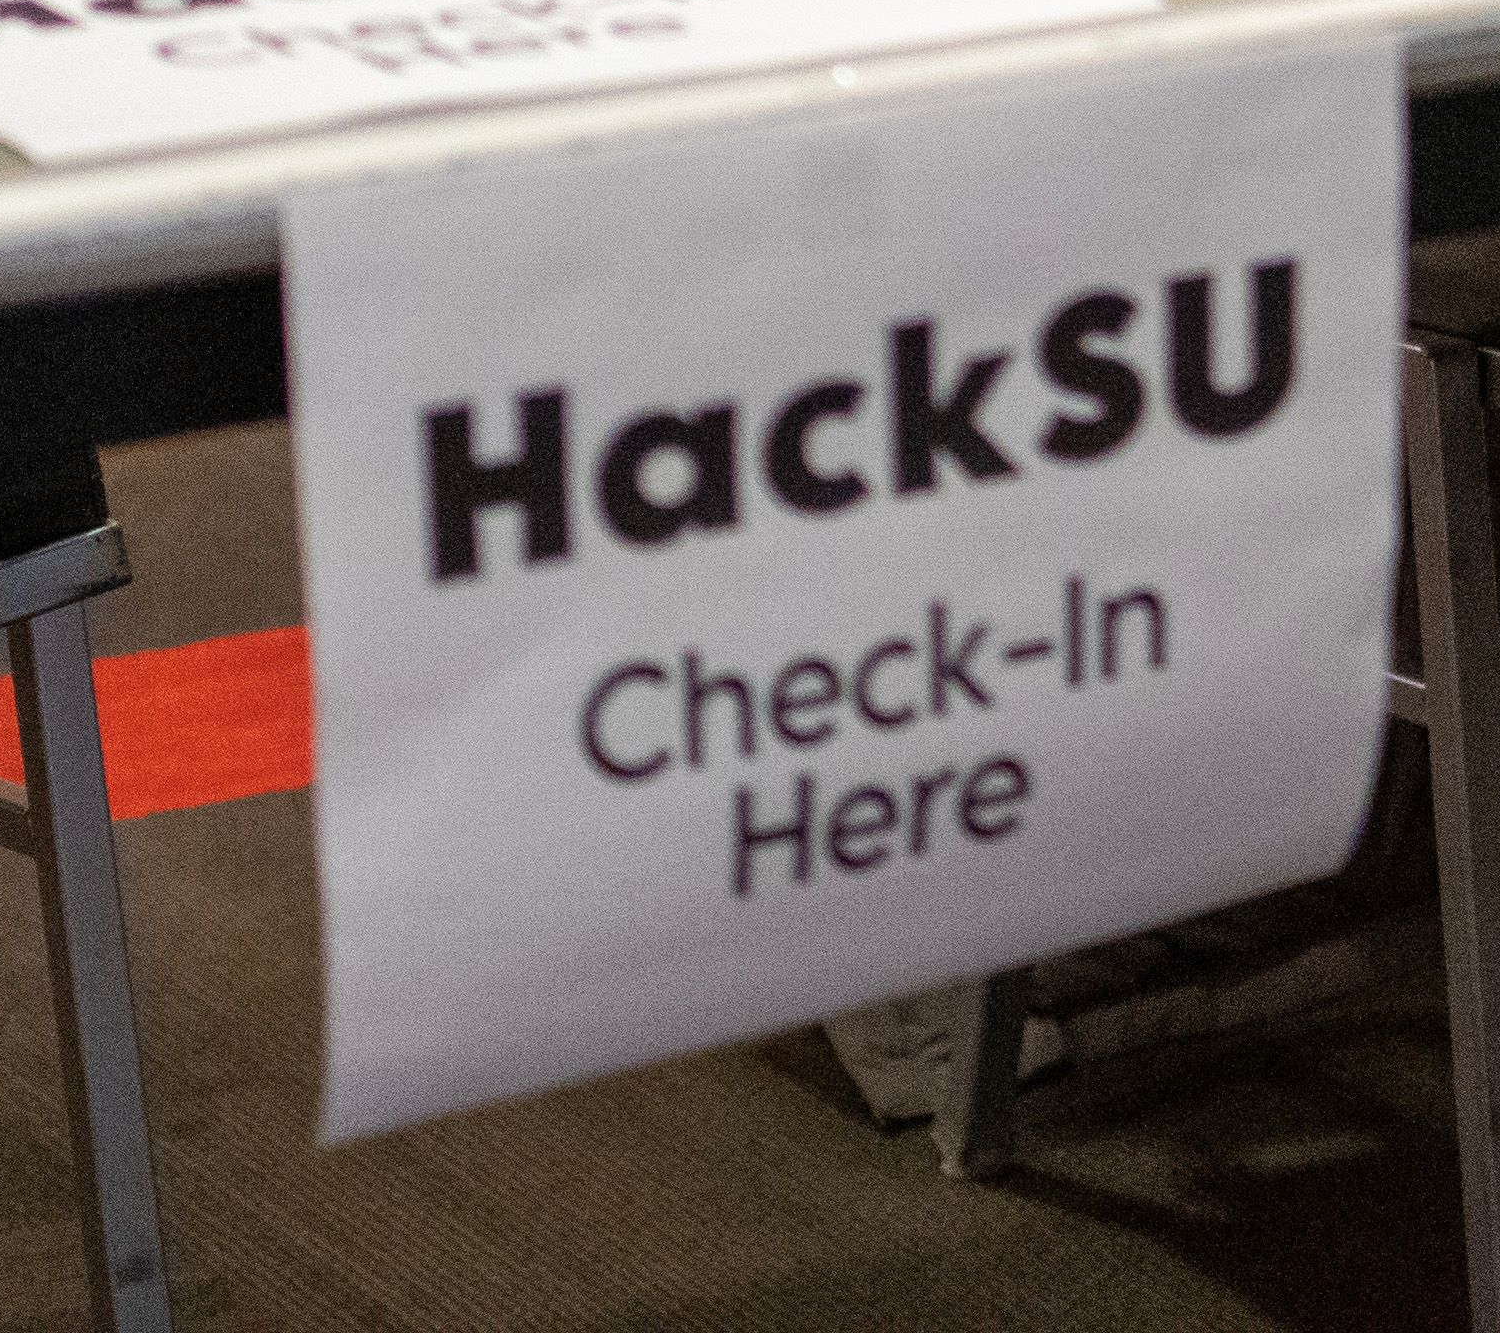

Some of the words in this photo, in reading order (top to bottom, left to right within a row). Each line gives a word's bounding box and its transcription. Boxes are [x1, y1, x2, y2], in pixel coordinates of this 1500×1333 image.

[419, 255, 1301, 586] HackSU
[579, 576, 1168, 784] Check-In
[729, 752, 1035, 901] Here
